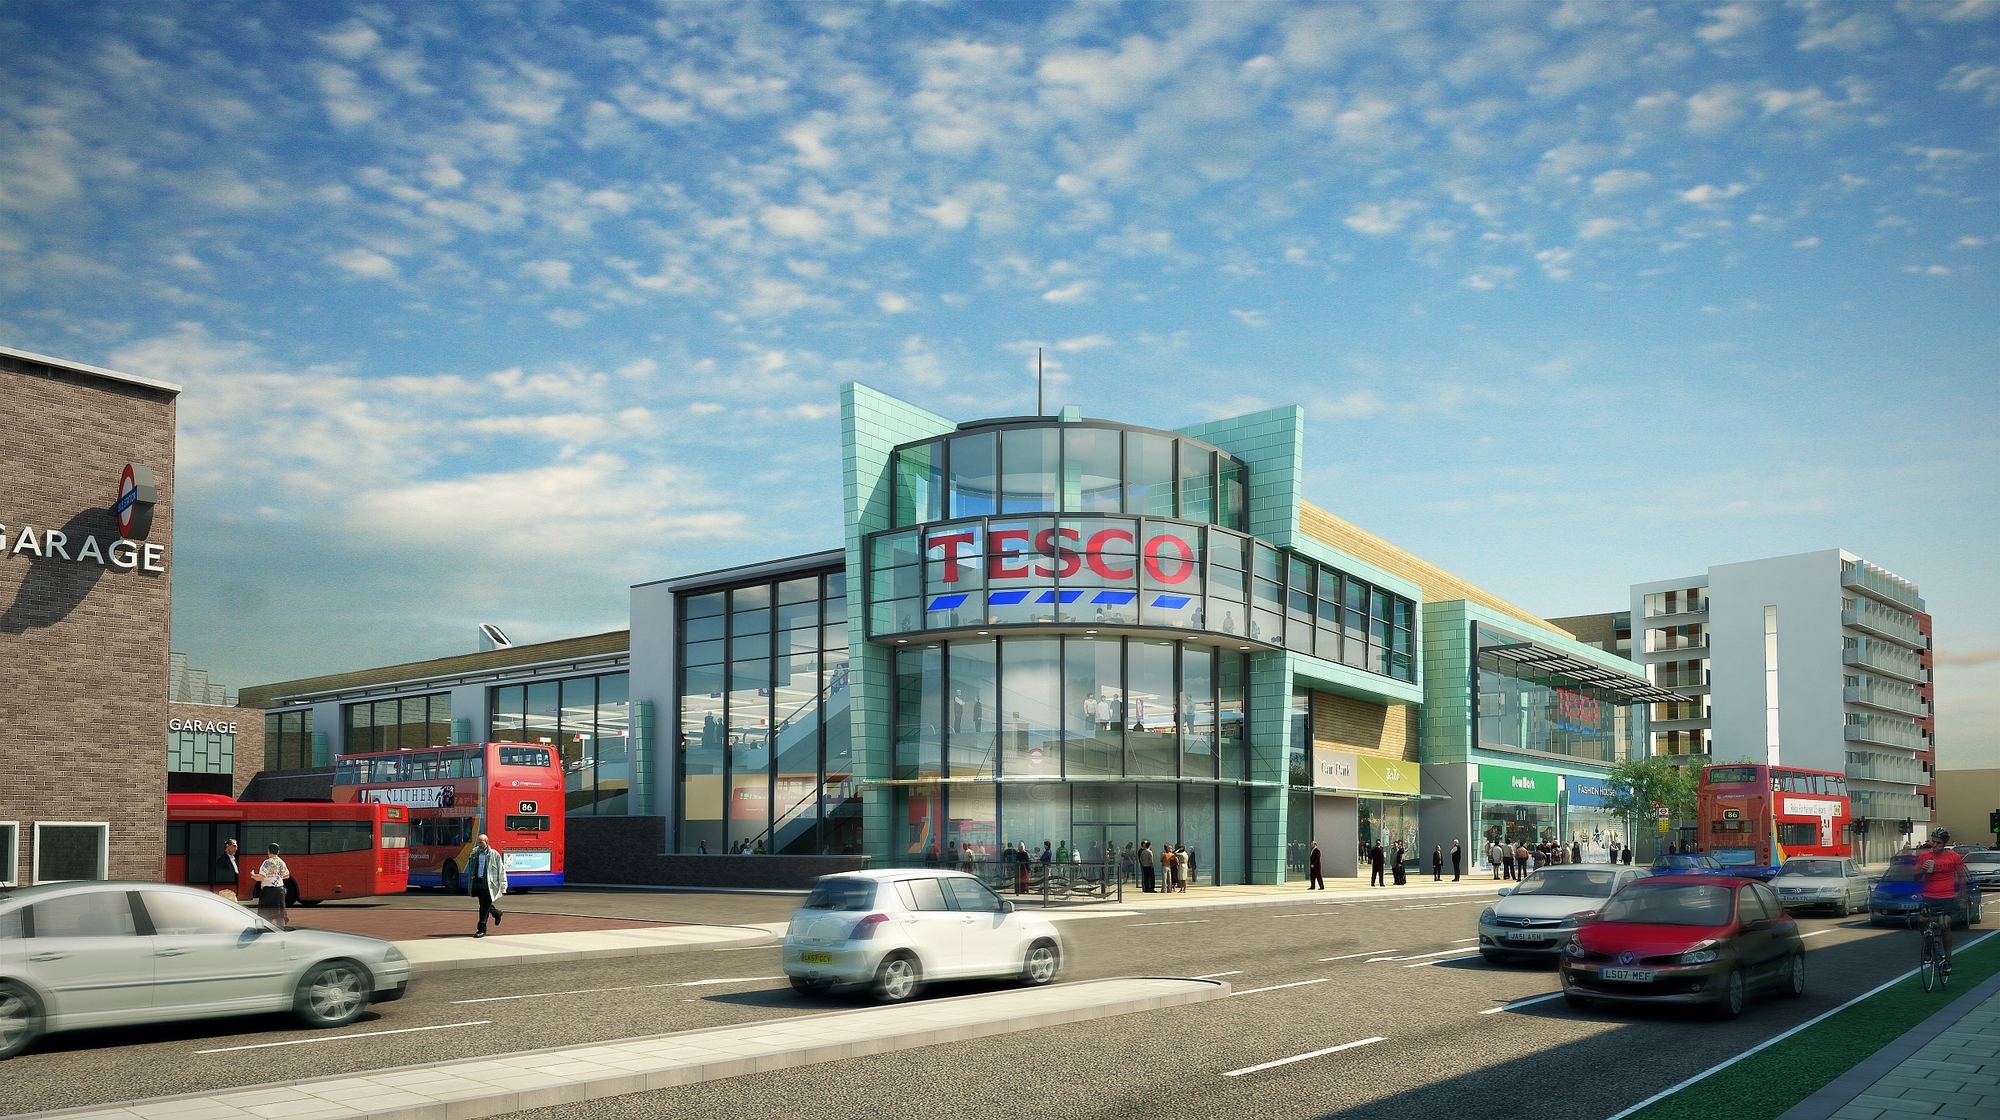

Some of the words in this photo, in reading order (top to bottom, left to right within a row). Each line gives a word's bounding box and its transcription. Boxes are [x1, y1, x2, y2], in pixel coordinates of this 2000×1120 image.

[0, 523, 165, 572] ARAGE
[928, 528, 1194, 584] TESCO
[1556, 687, 1599, 722] TESCO
[169, 718, 237, 734] GARAGE
[1321, 760, 1333, 776] Car
[1335, 761, 1351, 777] Park
[386, 788, 435, 803] SLITHER
[1605, 969, 1628, 980] LS07
[1632, 971, 1651, 982] MEF
